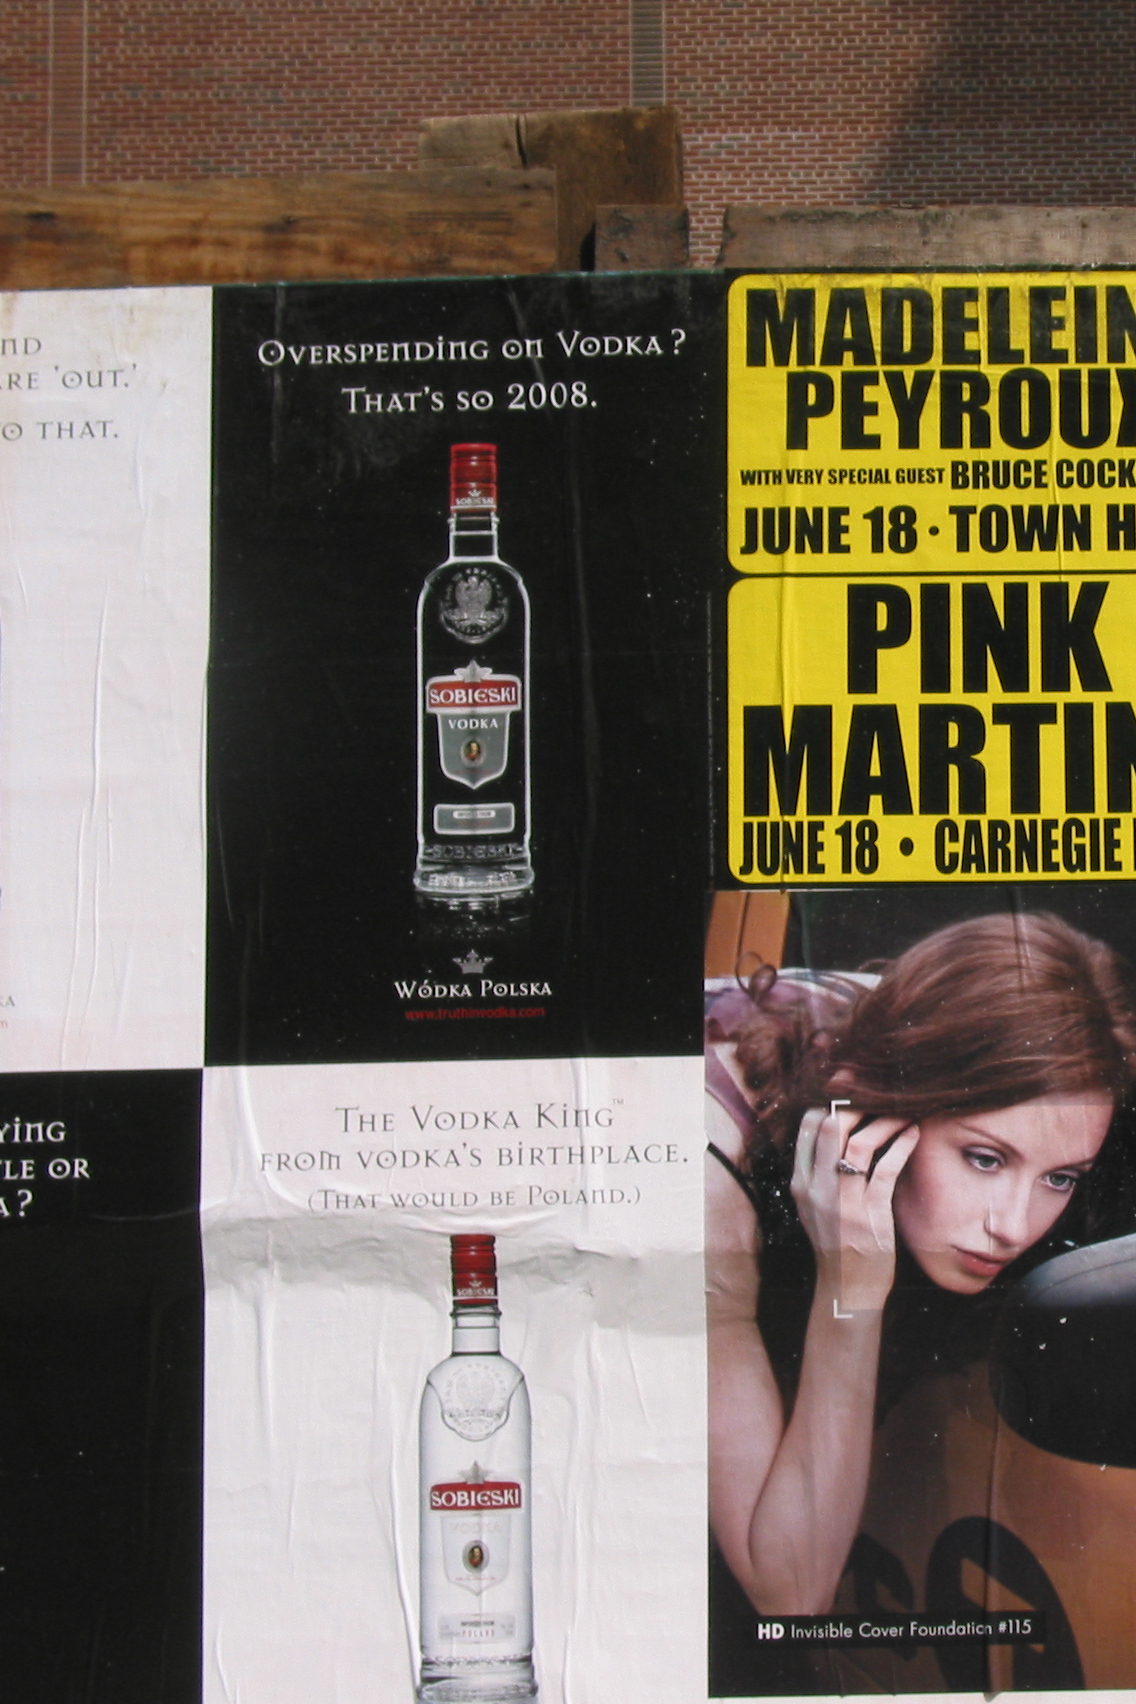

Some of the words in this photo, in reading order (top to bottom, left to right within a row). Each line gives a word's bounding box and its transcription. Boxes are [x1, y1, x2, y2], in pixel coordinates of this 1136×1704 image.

[0, 372, 39, 390] RE
[507, 381, 598, 411] 2008.
[36, 420, 119, 440] THAT.
[740, 470, 782, 485] WITH
[786, 470, 824, 485] VERY
[828, 469, 891, 484] SPECIAL
[896, 467, 945, 484] GUEST
[951, 459, 1048, 490] BRUCE
[740, 507, 851, 555] JUNE
[863, 505, 917, 553] 18
[949, 503, 1091, 553] TOWN
[847, 581, 1114, 694] PINK
[430, 686, 516, 705] SOBIESKI
[448, 718, 498, 730] VODKA
[739, 821, 825, 875] JUNE
[835, 819, 879, 874] 18
[934, 817, 1123, 873] CARNEGIE
[480, 979, 552, 997] POLSKA
[260, 1150, 341, 1172] FROM
[357, 1141, 482, 1170] VODKA'S
[0, 1159, 35, 1180] LE
[48, 1158, 90, 1180] OR
[391, 1191, 478, 1209] WOULD
[490, 1191, 516, 1207] BE
[431, 1488, 519, 1507] SOBIESKI
[757, 1623, 785, 1640] HD
[791, 1621, 853, 1639] Invisible
[858, 1622, 903, 1638] Cover
[910, 1619, 993, 1637] Foundation
[998, 1619, 1032, 1635] #115
